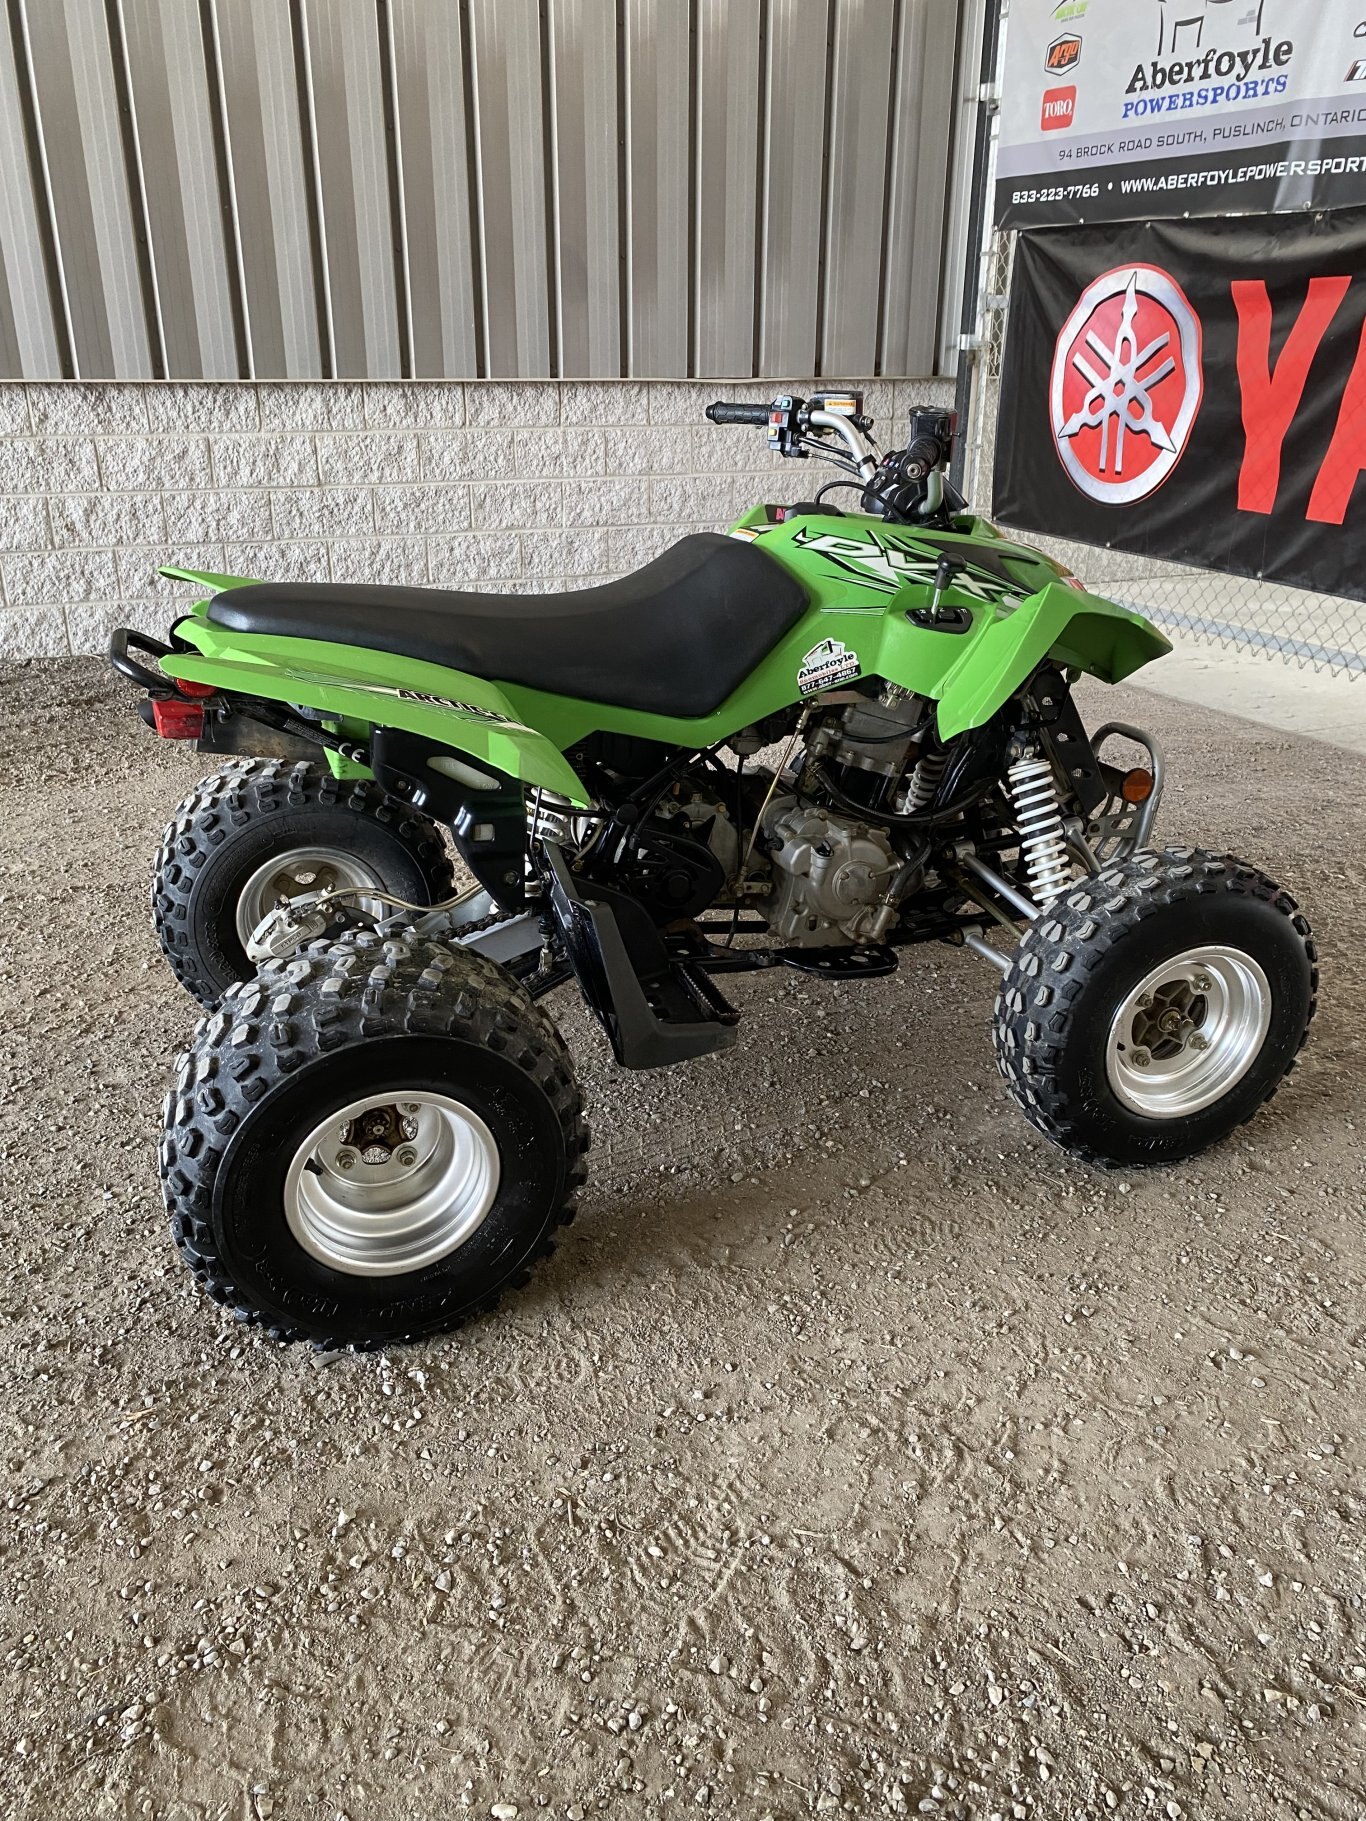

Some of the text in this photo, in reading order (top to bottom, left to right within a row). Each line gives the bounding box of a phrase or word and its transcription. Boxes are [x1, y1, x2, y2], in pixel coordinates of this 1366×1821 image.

[1048, 41, 1079, 67] Argo
[1125, 37, 1293, 94] Aberfoyle
[1044, 99, 1072, 118] TORO
[1122, 74, 1288, 119] POWERSPORTS
[1058, 150, 1073, 161] 94
[1076, 143, 1114, 158] BROCK
[1118, 138, 1152, 153] ROAD
[1156, 130, 1207, 147] SOUTH,
[1212, 118, 1286, 141] PUSLINCH,
[1012, 183, 1099, 204] 833-223-7766
[799, 654, 854, 679] Aberfoyle
